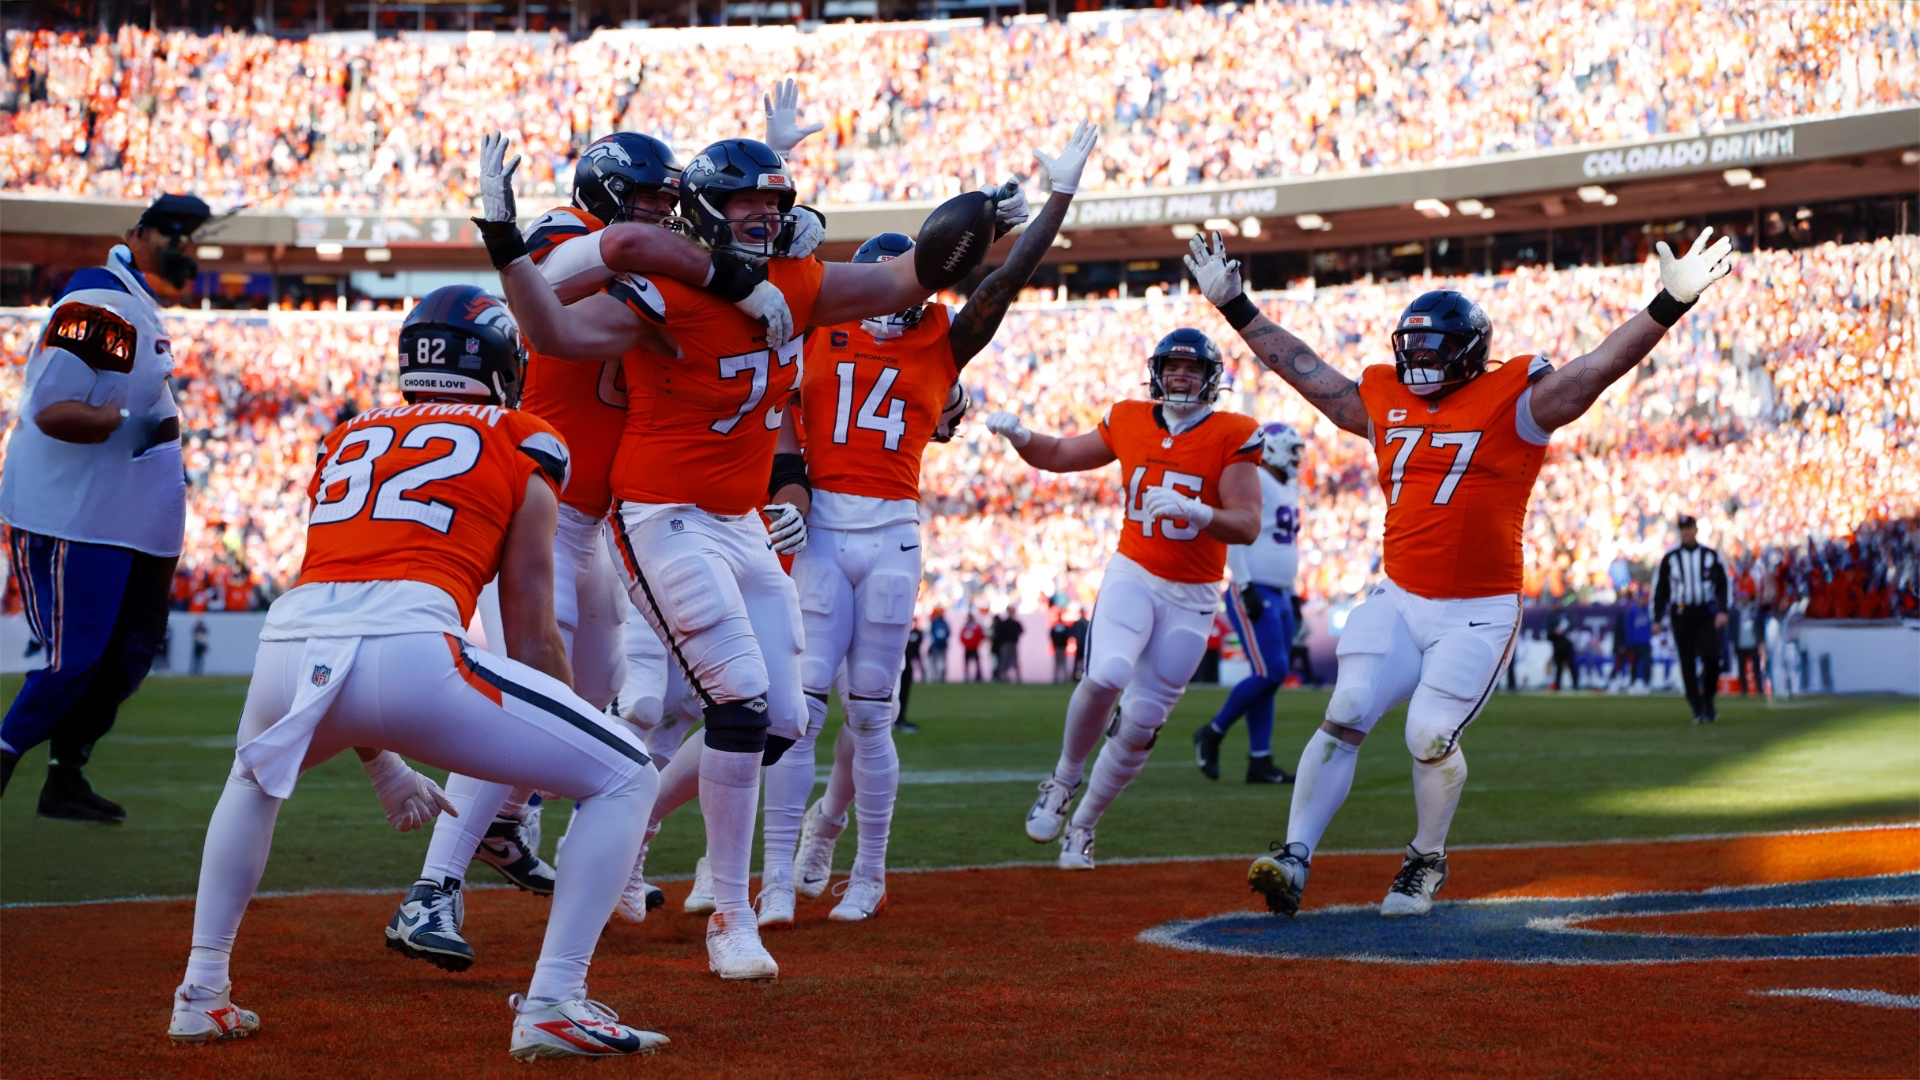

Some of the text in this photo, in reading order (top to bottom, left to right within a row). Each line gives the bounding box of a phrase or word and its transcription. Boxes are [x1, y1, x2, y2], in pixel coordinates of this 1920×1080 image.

[1582, 140, 1708, 177] COLORADO
[1078, 197, 1163, 224] DRIVES
[1165, 193, 1216, 219] PHIL
[1218, 188, 1278, 216] LONG
[345, 217, 364, 240] 7
[431, 218, 450, 242] 3
[416, 338, 446, 364] 82
[830, 331, 849, 347] C
[854, 352, 899, 365] BRONCOS
[404, 379, 466, 389] CHOOSE LOVE
[831, 361, 908, 451] 14
[1387, 408, 1407, 422] C
[307, 422, 484, 535] 82
[1385, 426, 1484, 506] 77
[1127, 466, 1205, 542] 45
